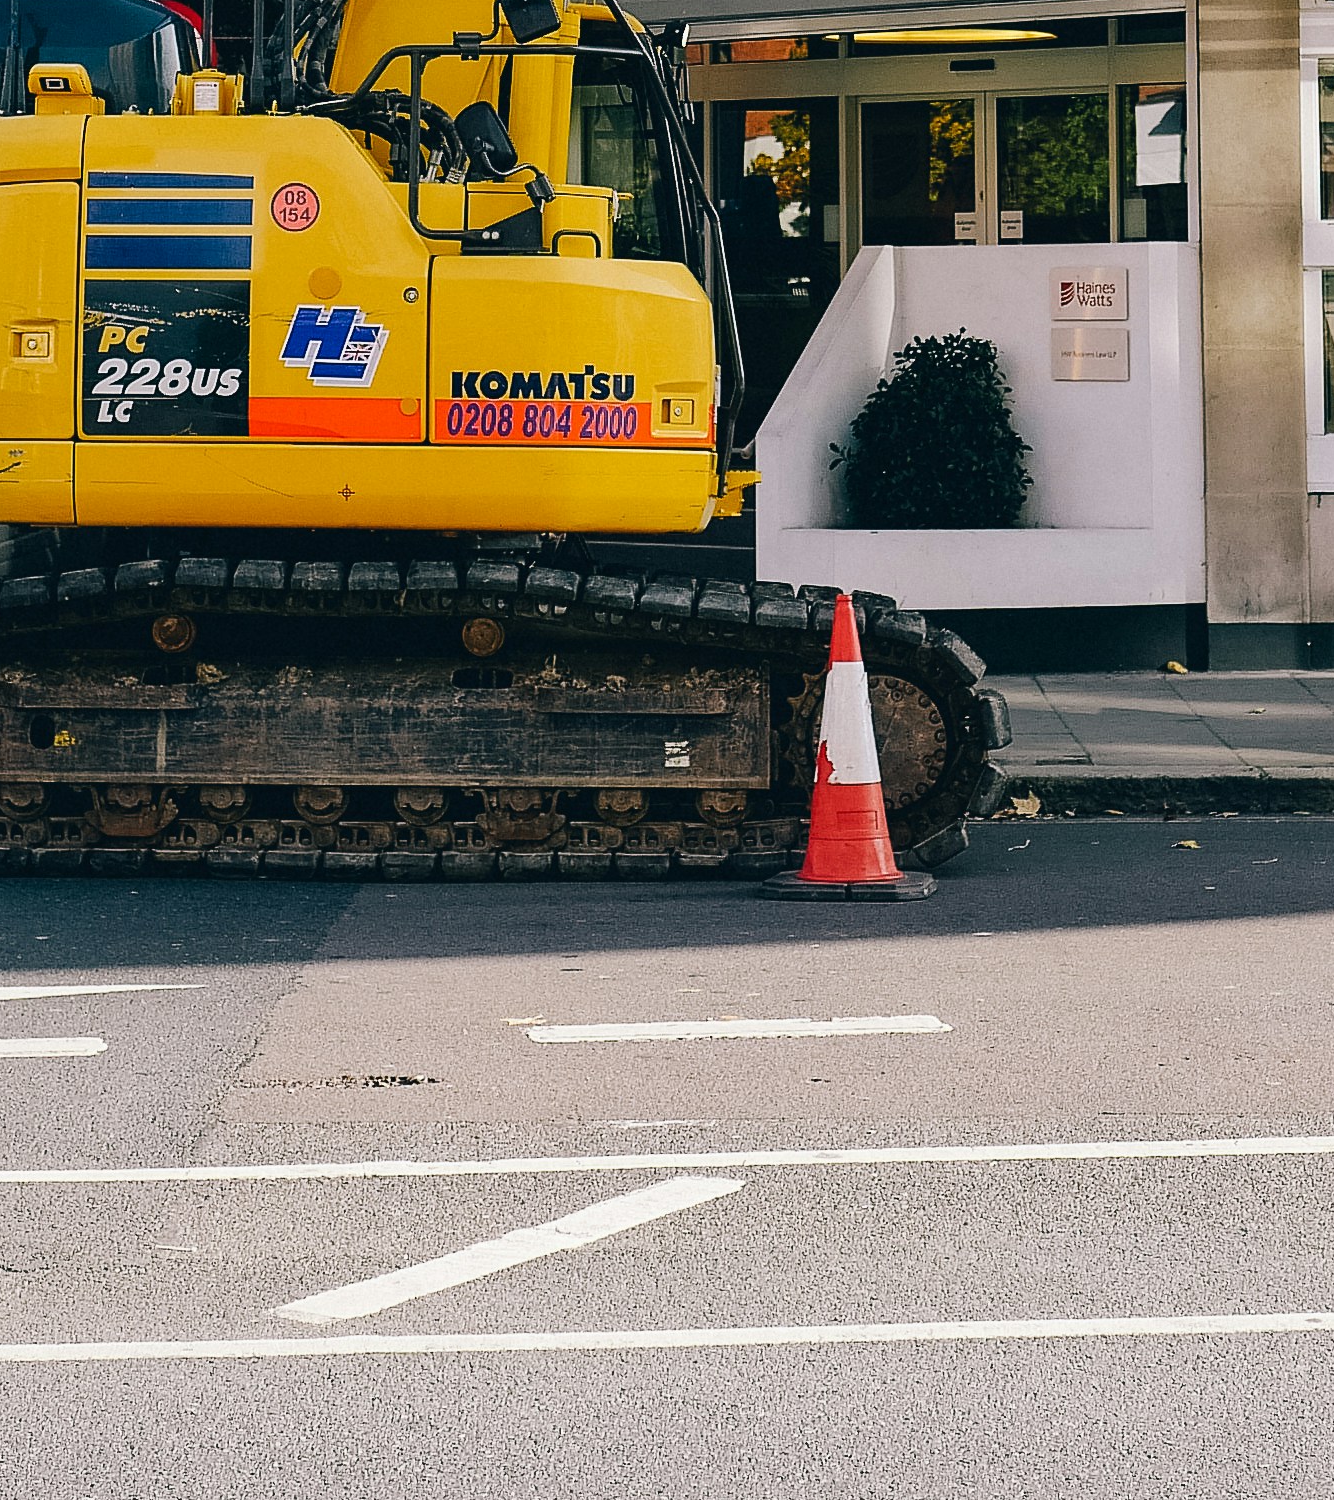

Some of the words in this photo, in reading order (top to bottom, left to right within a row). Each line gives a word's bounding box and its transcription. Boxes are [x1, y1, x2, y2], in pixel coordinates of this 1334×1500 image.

[284, 190, 307, 205] 08
[278, 206, 312, 223] 154
[1076, 282, 1116, 294] Haines
[1076, 294, 1113, 307] Watts
[98, 325, 150, 353] PC
[451, 365, 635, 401] KOMATSU
[97, 400, 134, 423] LC
[447, 402, 513, 437] 0208
[523, 404, 572, 438] 804
[579, 405, 637, 440] 2000
